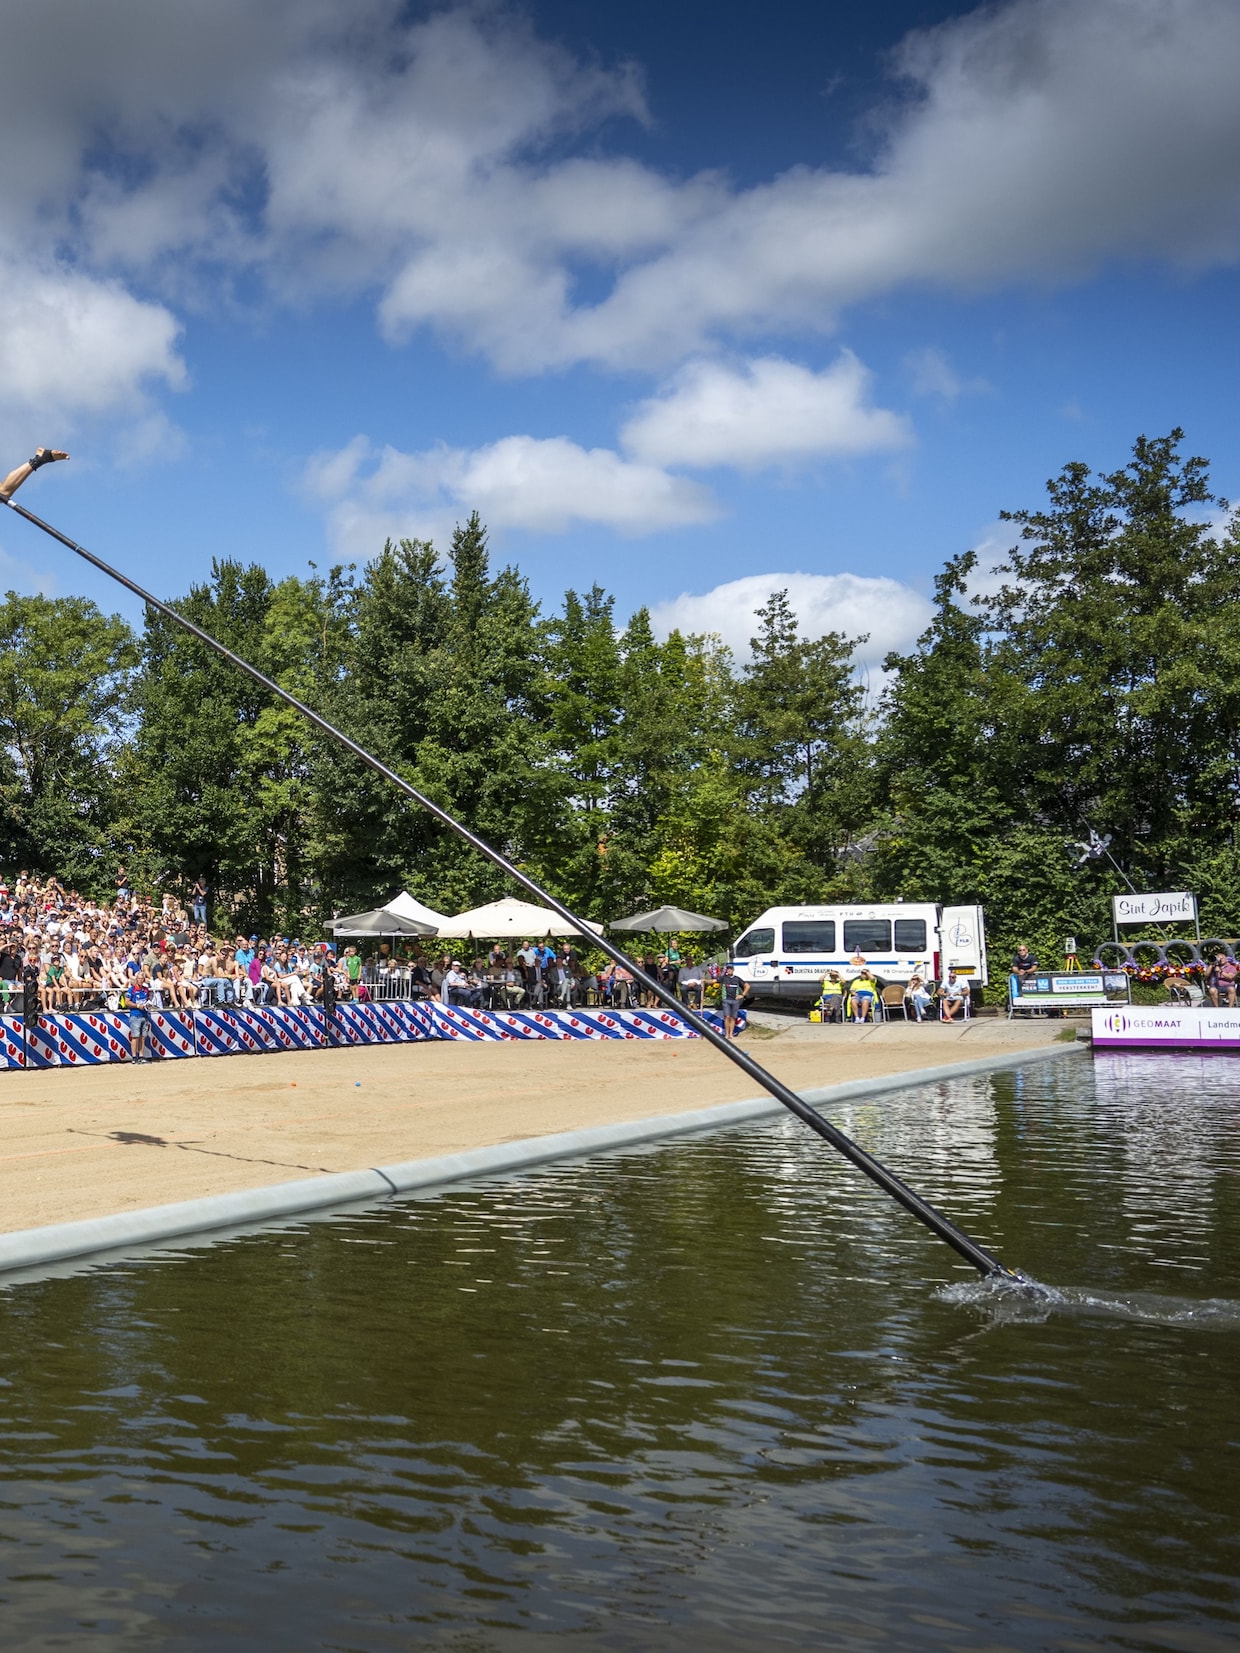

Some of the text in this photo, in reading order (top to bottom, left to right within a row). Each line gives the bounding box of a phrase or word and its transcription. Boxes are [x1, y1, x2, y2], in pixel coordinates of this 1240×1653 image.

[1119, 898, 1190, 916] Sint Japik
[1133, 1020, 1182, 1028] GEOMAAT
